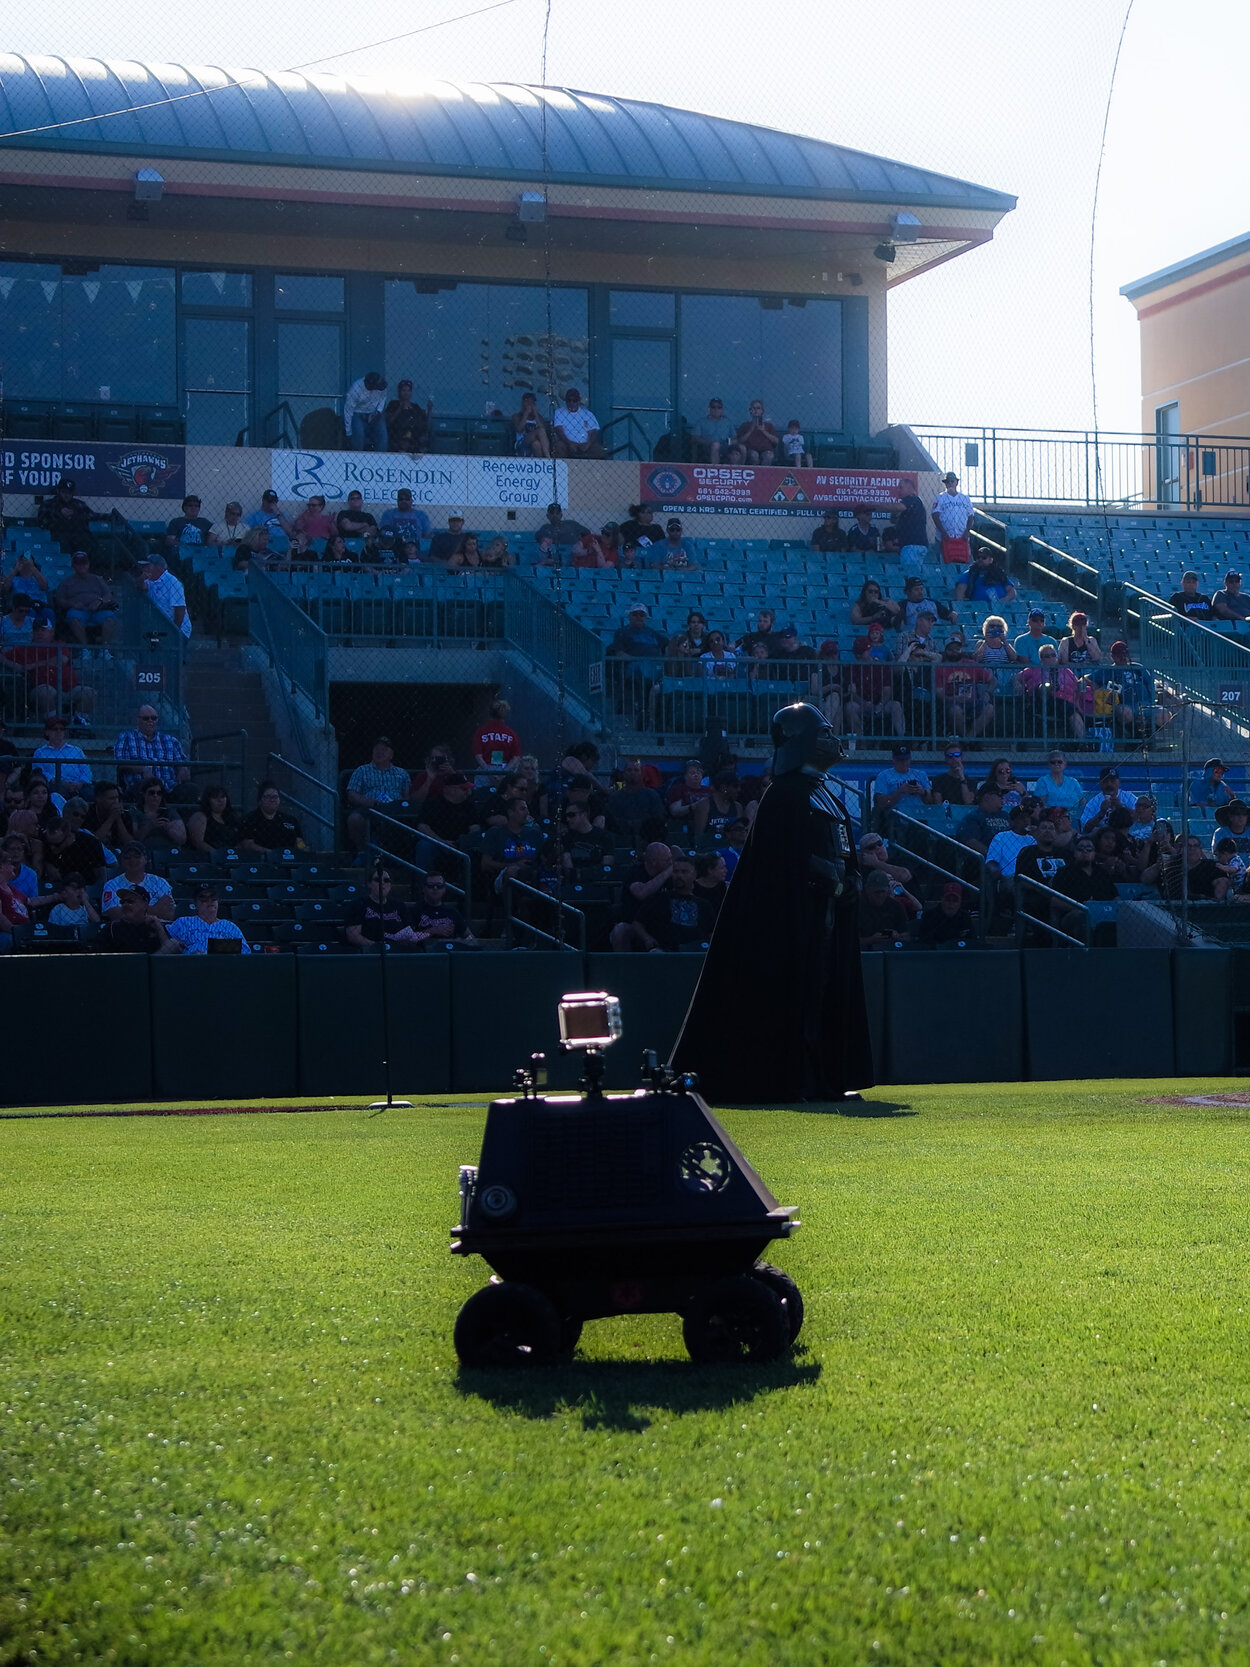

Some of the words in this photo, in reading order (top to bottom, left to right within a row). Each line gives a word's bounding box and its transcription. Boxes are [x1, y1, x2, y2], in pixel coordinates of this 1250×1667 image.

[21, 452, 96, 469] SPONSOR
[121, 454, 167, 470] JETHAWKS
[482, 460, 554, 474] Renewable
[19, 470, 62, 486] YOUR
[345, 462, 453, 485] ROSENDIN
[693, 467, 755, 480] OPSEC
[496, 475, 541, 491] Energy
[698, 478, 750, 486] SECURITY
[816, 475, 827, 485] AV
[829, 475, 868, 487] SECURITY
[363, 488, 433, 501] ELECRIC
[499, 490, 539, 505] Group
[723, 507, 747, 515] STATE
[749, 508, 788, 516] CERTIFIED
[138, 672, 161, 683] 205
[1221, 691, 1241, 701] 207
[481, 732, 513, 743] STAFF
